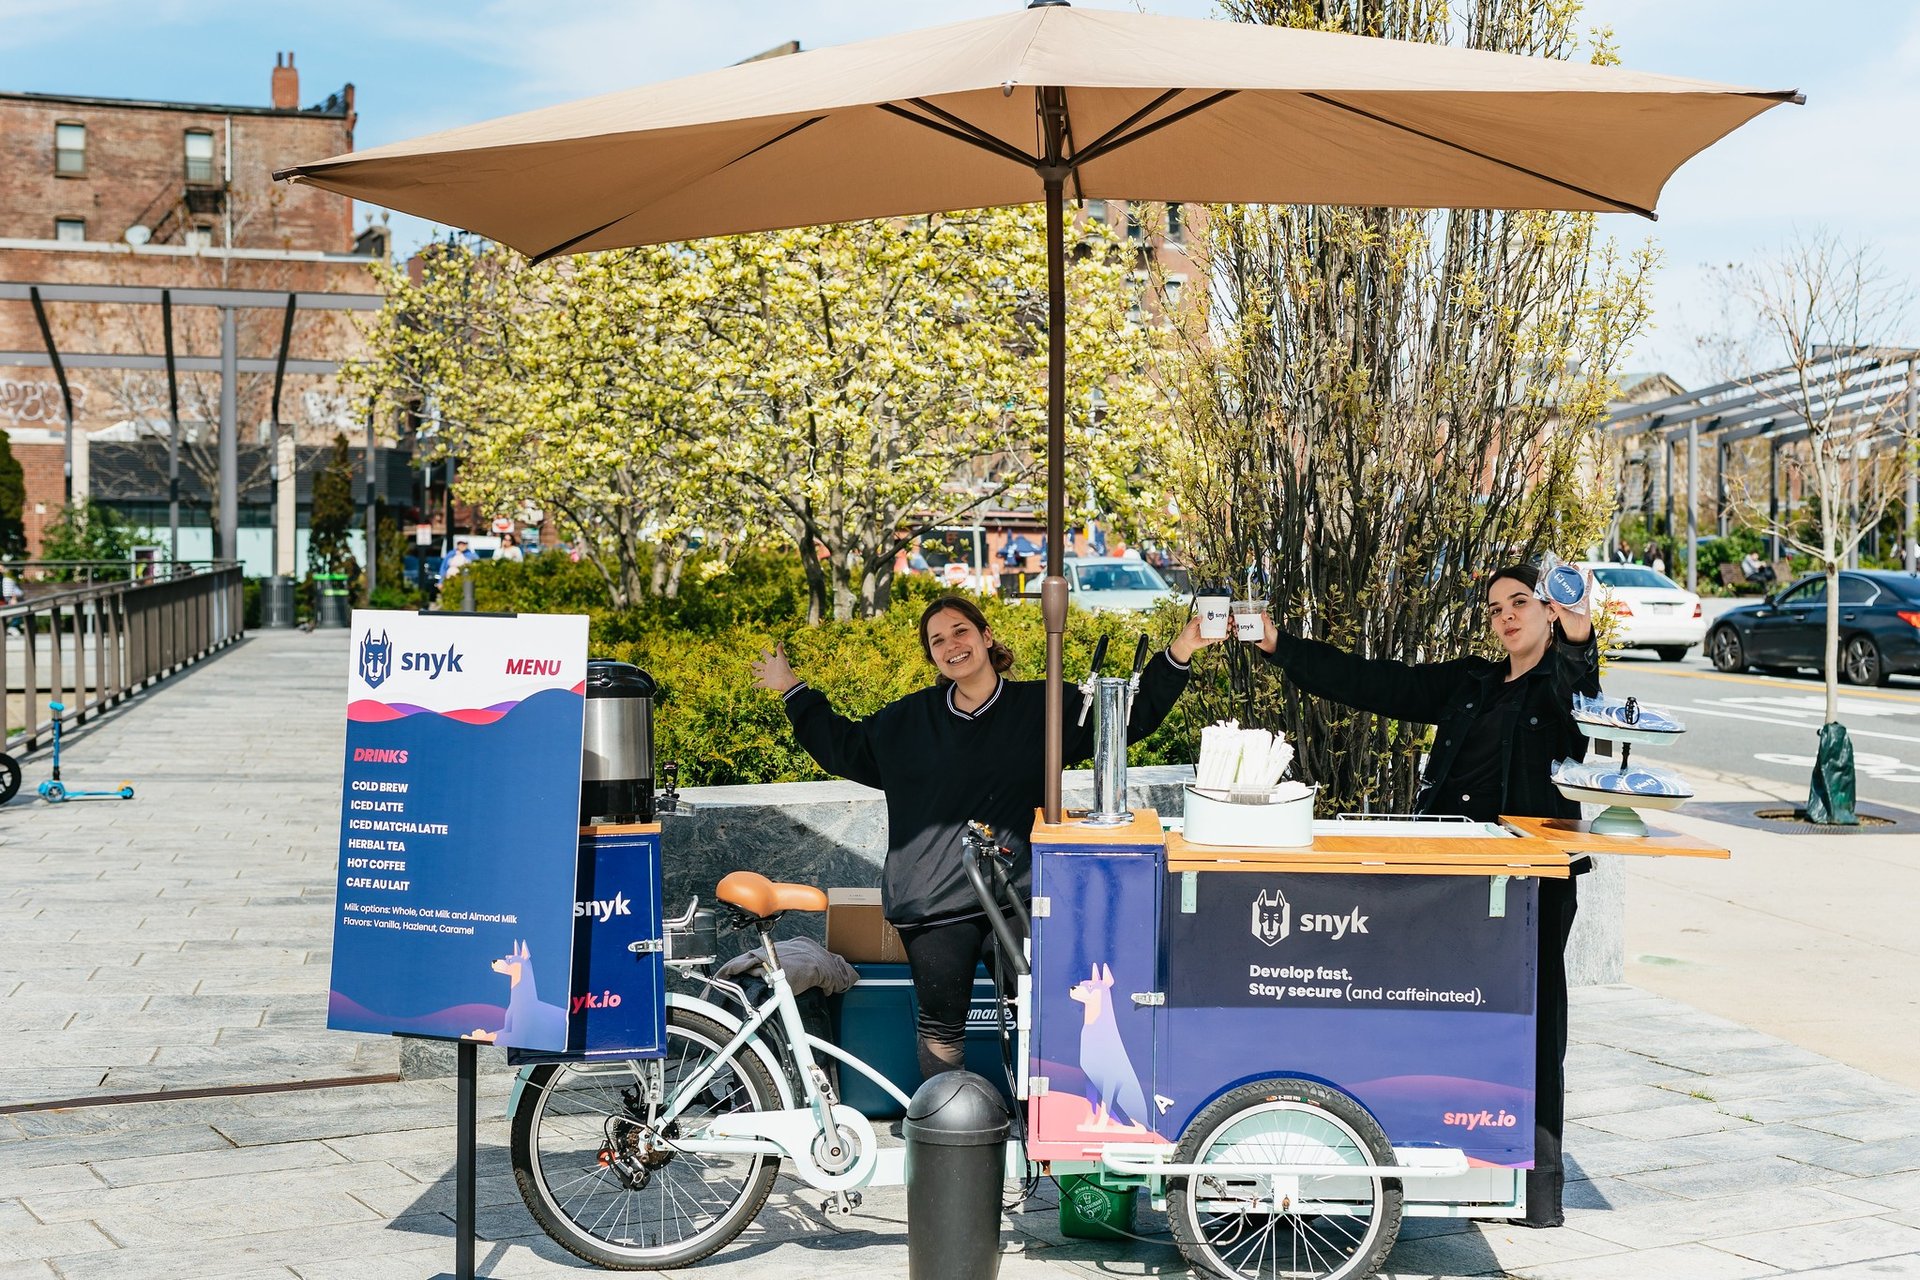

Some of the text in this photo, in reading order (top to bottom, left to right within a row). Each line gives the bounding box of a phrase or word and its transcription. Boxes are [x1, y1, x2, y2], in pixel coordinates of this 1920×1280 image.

[1562, 581, 1577, 598] snyk
[401, 643, 464, 680] snyk
[505, 658, 562, 676] MENU
[353, 747, 409, 764] DRINKS
[351, 780, 409, 793] COLD BREW
[350, 799, 404, 813] ICED LATTE
[349, 819, 449, 835] ICED MATCHA LATTE
[348, 838, 406, 851] HERBAL TEA
[347, 858, 406, 871] HOT COFFEE
[346, 877, 410, 891] CAFE AU LAIT
[344, 902, 518, 924] Milk options: Whole, Oat Milk and Almond Milk
[574, 891, 632, 922] snyk
[343, 916, 373, 927] Flavors:
[373, 919, 401, 930] Vanilla,
[439, 924, 475, 935] Caramel
[1300, 905, 1369, 940] snyk
[1249, 964, 1353, 983] Develop fast.
[572, 990, 621, 1013] yk.io
[1249, 982, 1487, 1006] Stay secure (and caffeinated).
[1443, 1109, 1517, 1130] snyk.io
